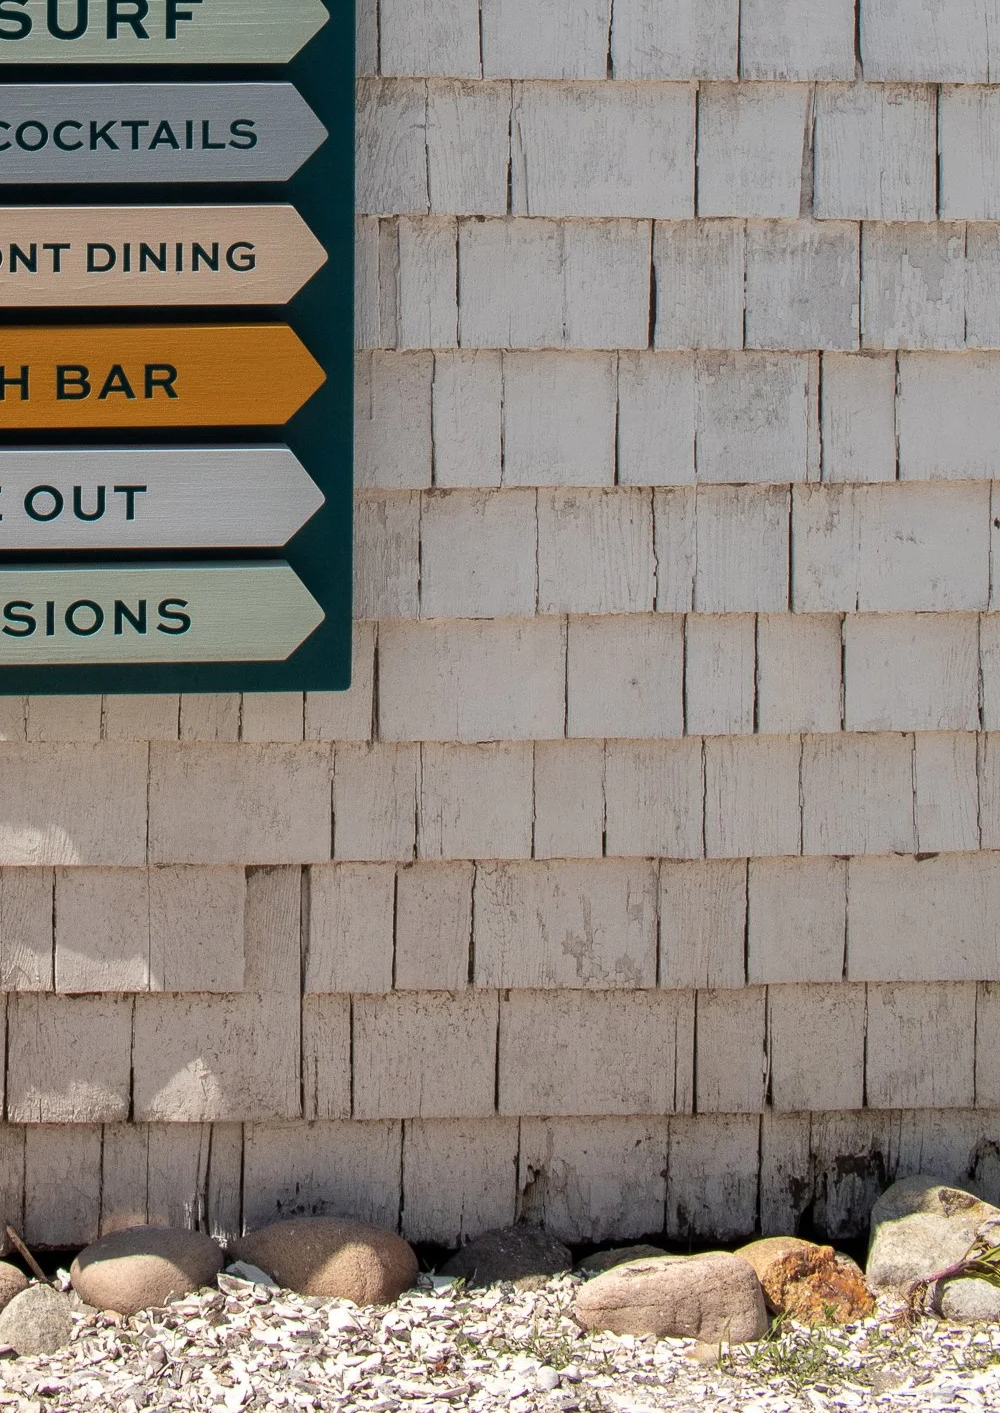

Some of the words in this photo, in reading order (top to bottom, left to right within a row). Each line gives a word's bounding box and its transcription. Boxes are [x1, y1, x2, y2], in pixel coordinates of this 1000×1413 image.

[87, 242, 255, 272] DINING
[57, 364, 178, 400] BAR
[24, 485, 147, 521] OUT
